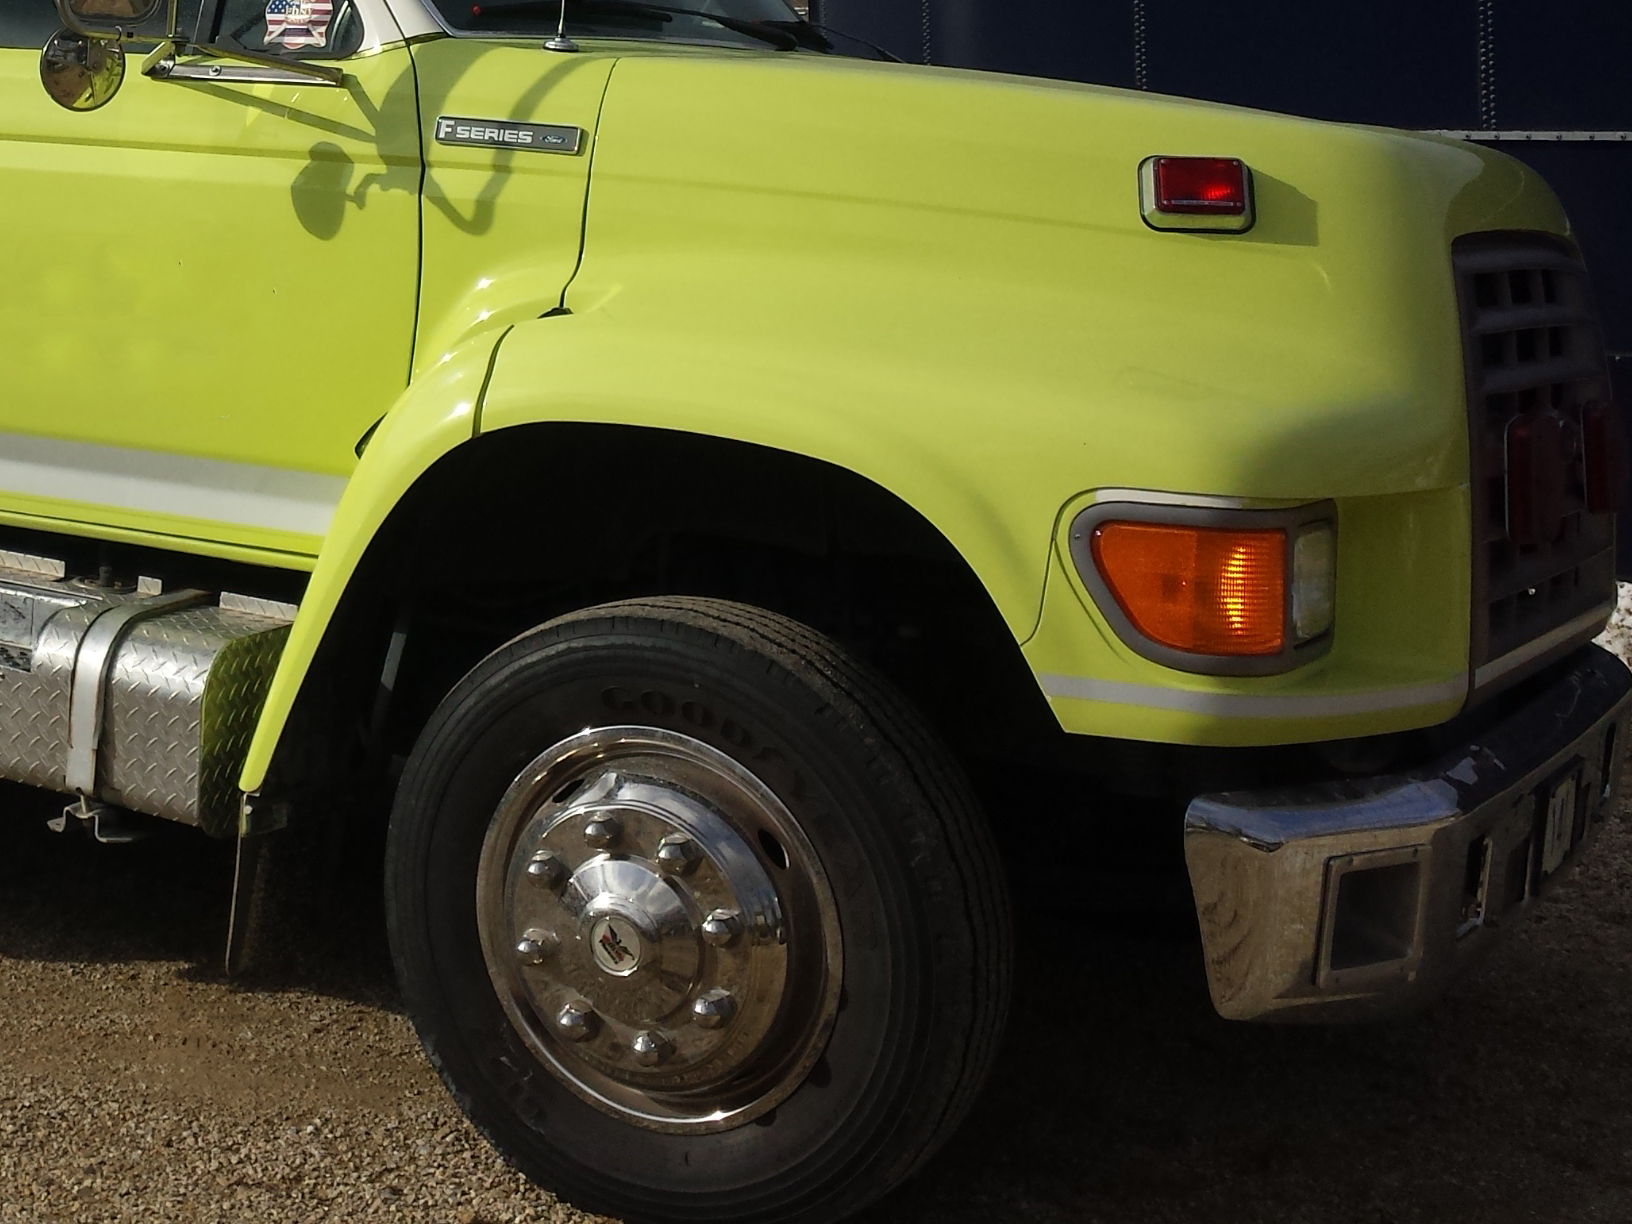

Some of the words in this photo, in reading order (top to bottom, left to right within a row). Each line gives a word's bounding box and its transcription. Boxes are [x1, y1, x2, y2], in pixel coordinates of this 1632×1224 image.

[438, 120, 455, 139] F
[455, 126, 534, 144] SERIES
[600, 685, 878, 951] GOODYEAR
